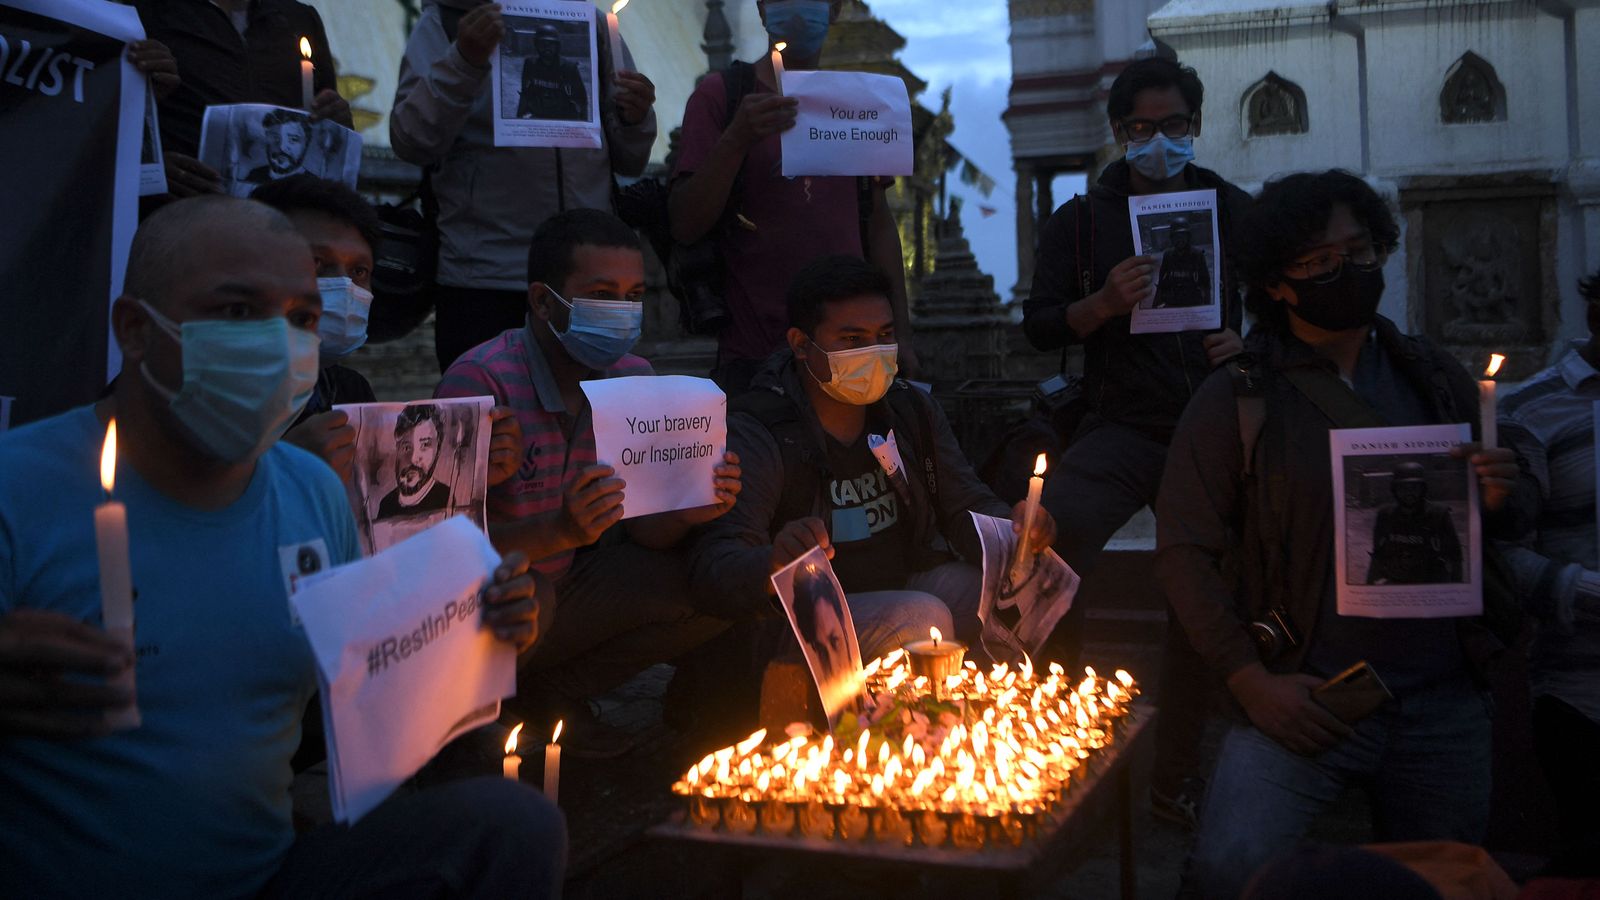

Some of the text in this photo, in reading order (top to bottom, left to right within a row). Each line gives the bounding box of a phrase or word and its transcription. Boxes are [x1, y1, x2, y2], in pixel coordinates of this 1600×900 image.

[829, 106, 879, 120] You are
[809, 127, 898, 144] Brave Enough
[626, 415, 712, 434] Your bravery
[621, 442, 713, 466] Our Inspiration
